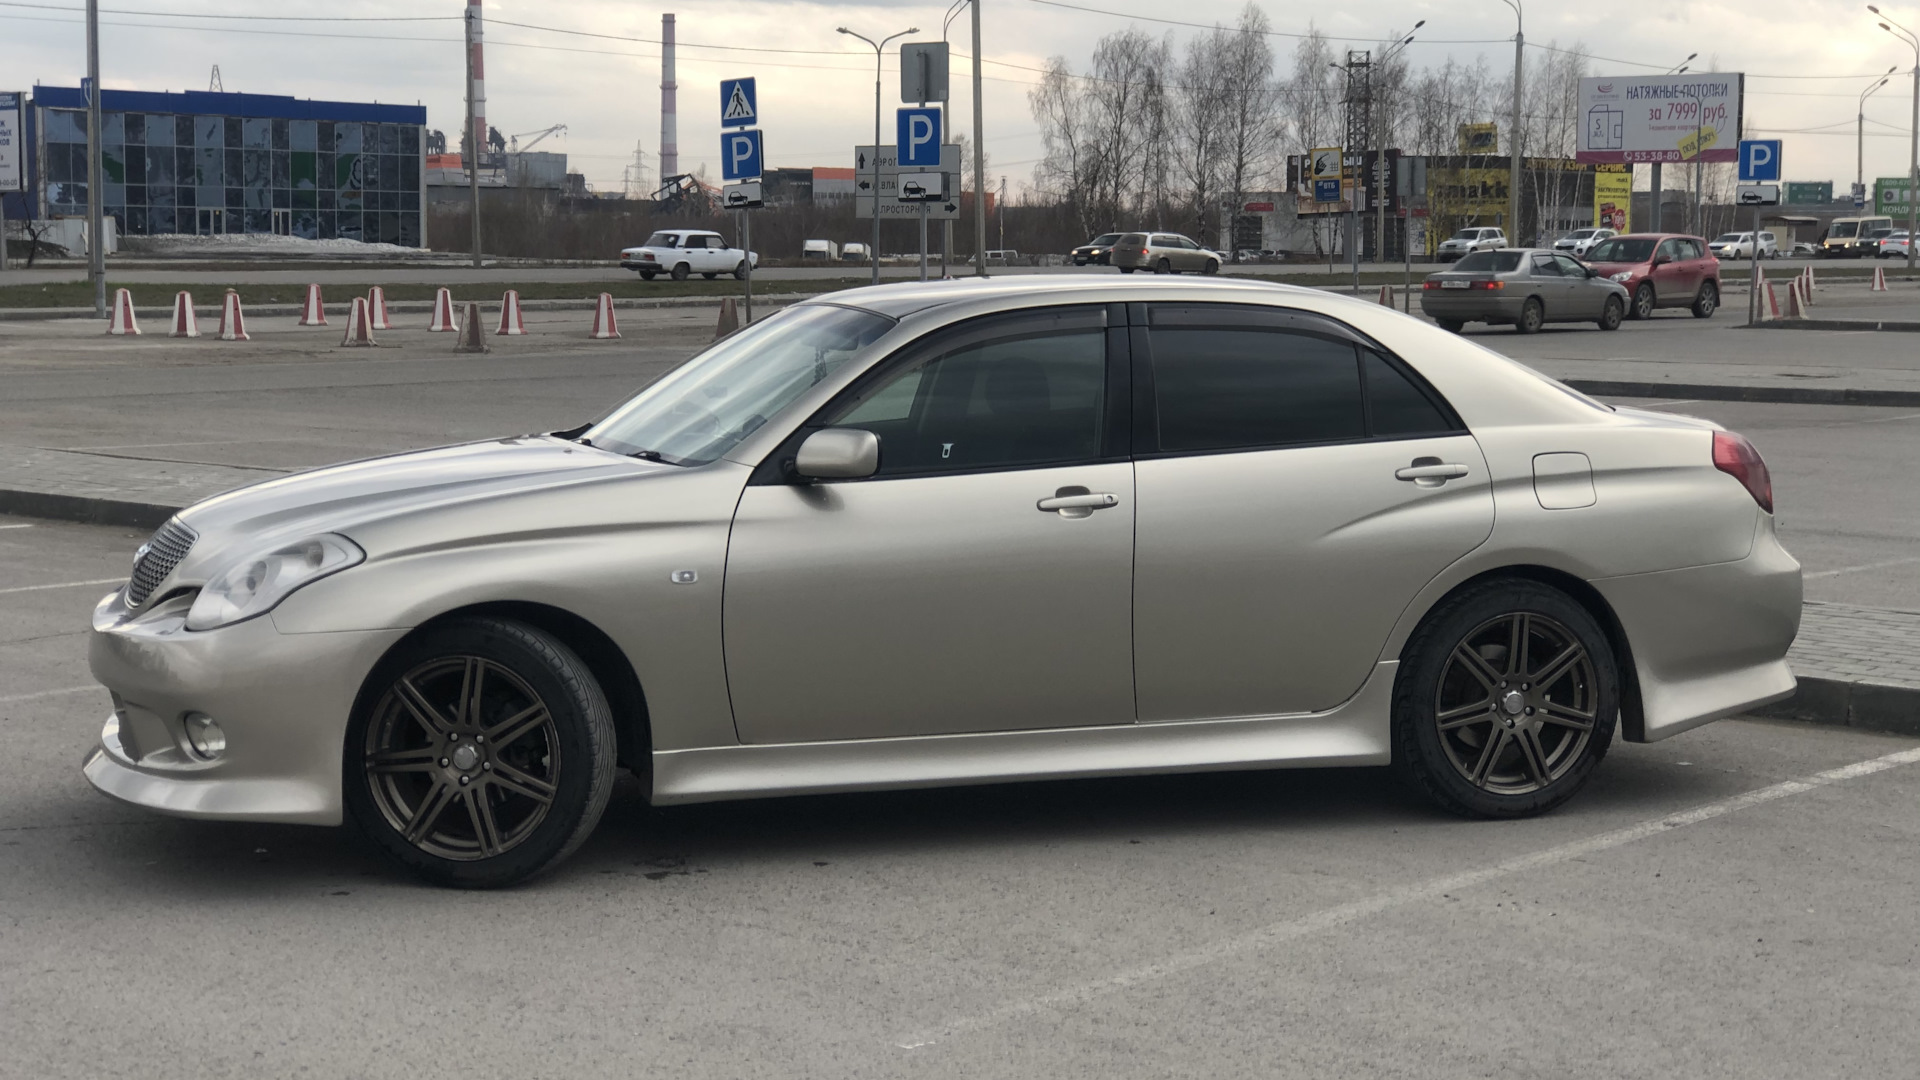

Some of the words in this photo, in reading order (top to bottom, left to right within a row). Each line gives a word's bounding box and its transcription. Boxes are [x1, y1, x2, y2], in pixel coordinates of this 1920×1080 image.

[1626, 85, 1679, 100] НАТЯЖНЫЕ
[1683, 83, 1728, 98] ПОТОЛКИ
[1649, 108, 1662, 121] за
[1667, 102, 1698, 120] 7999
[1703, 102, 1728, 125] руб.
[908, 114, 934, 161] P
[731, 135, 753, 175] P
[1634, 151, 1680, 161] 53-38-80
[1749, 144, 1772, 177] P
[1595, 163, 1627, 173] СЕРВИС
[1323, 182, 1336, 190] ВТБ
[871, 204, 931, 216] у.ПРОСТОРНЯ
